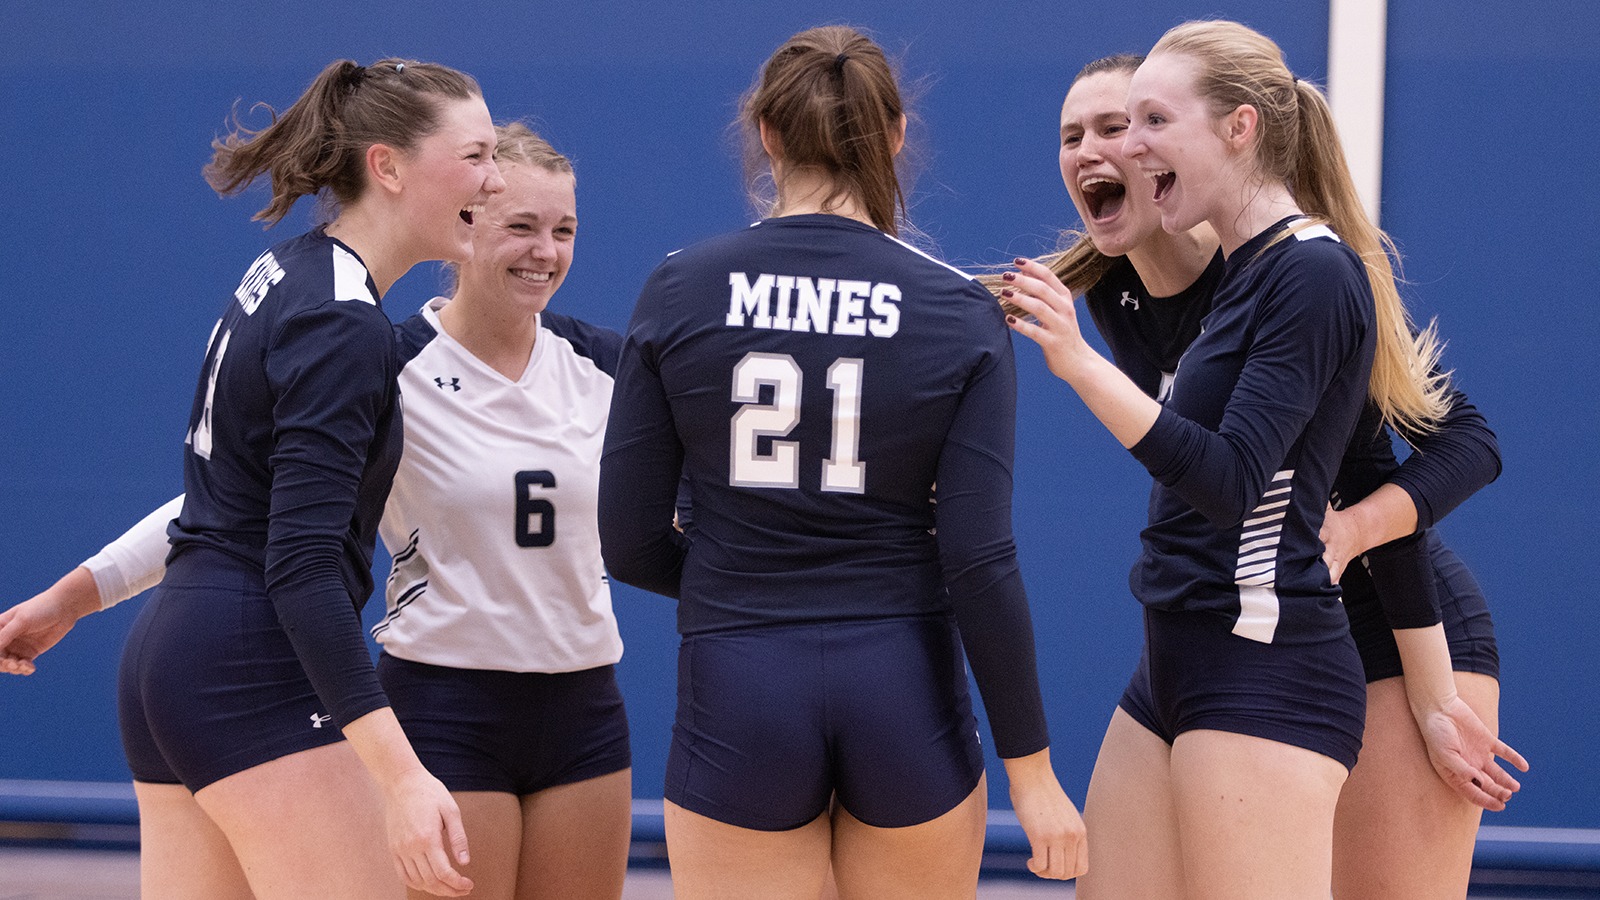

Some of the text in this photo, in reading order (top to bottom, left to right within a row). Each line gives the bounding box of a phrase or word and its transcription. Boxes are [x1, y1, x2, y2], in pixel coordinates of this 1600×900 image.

[726, 272, 902, 338] MINES
[729, 351, 866, 494] 21
[514, 470, 556, 547] 6
